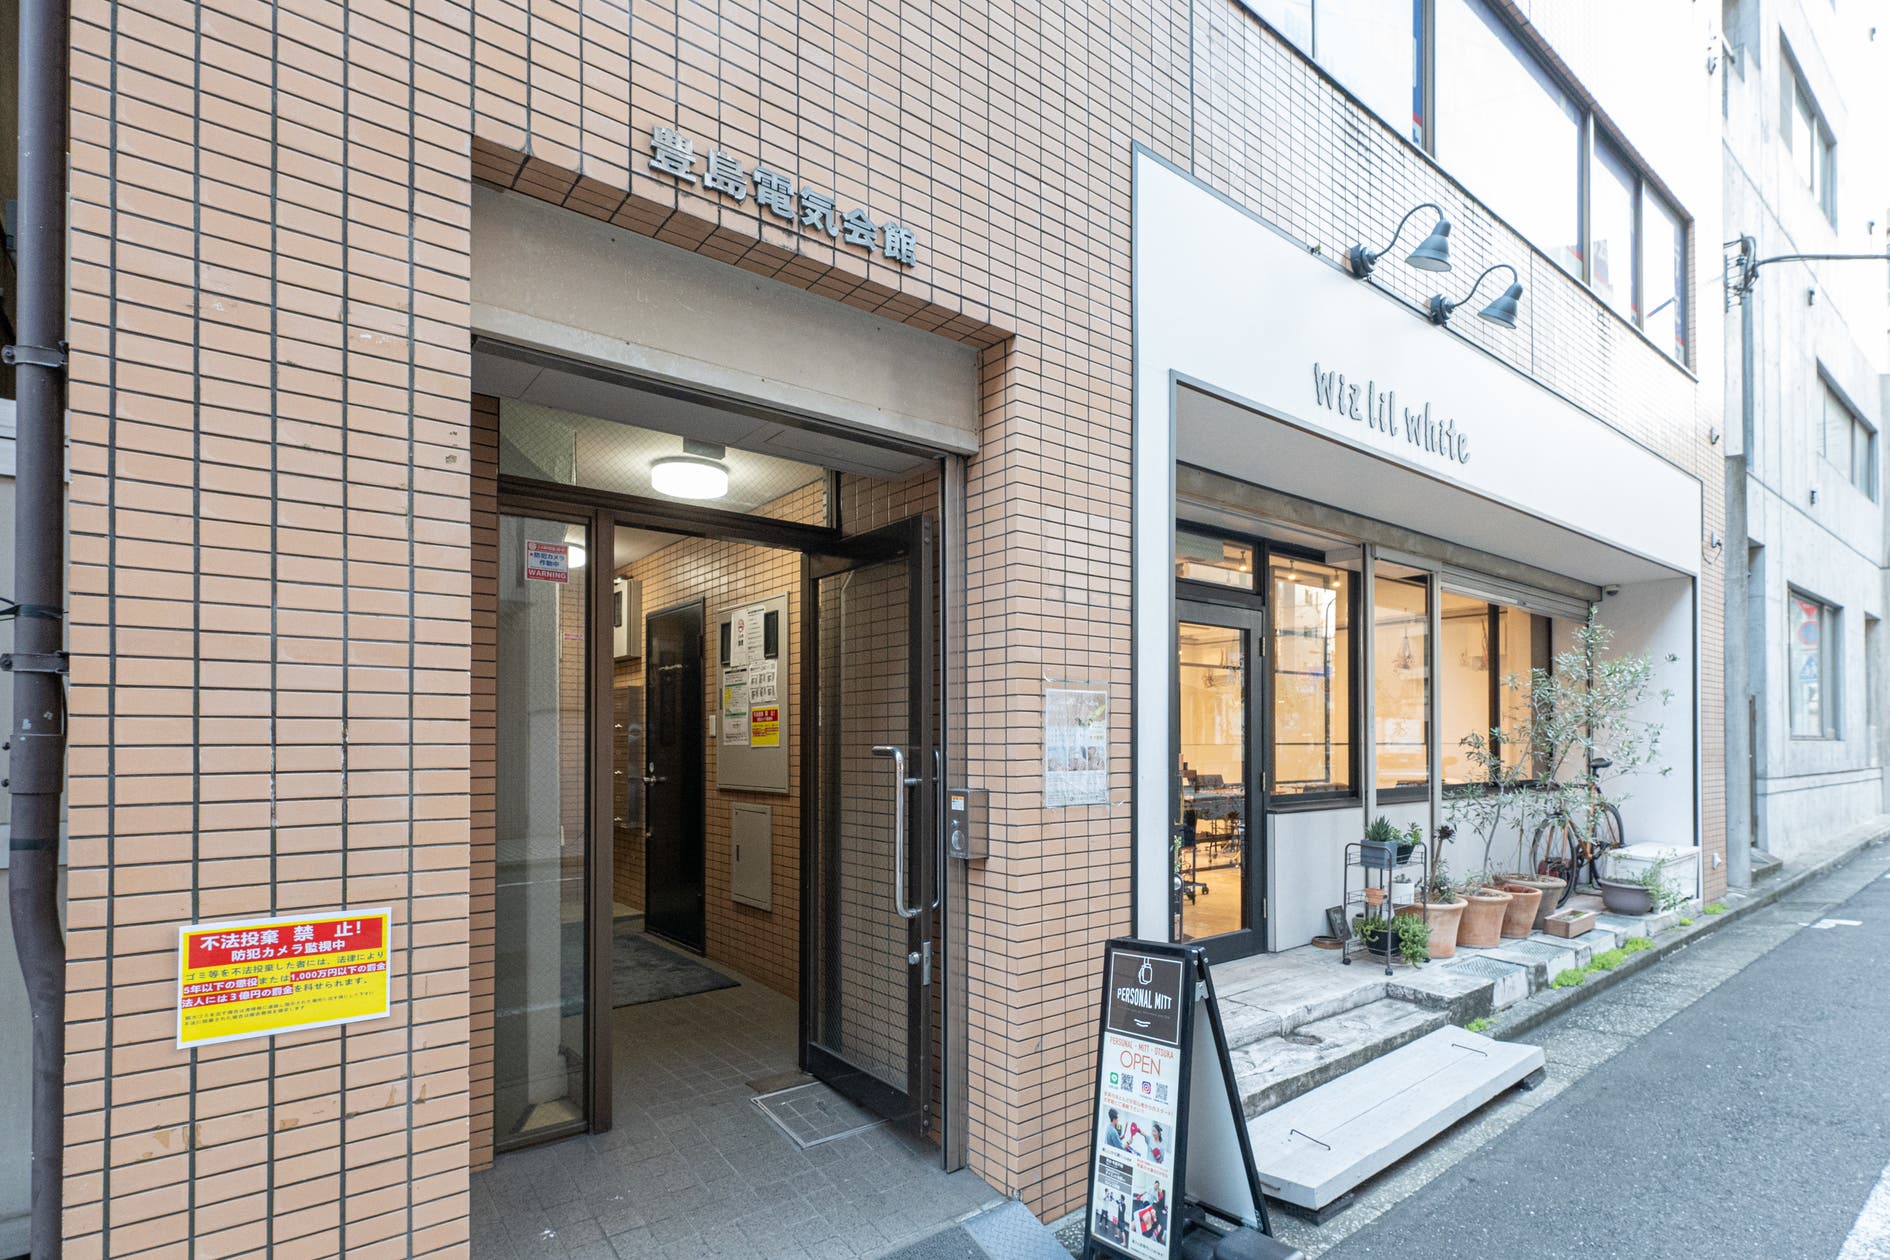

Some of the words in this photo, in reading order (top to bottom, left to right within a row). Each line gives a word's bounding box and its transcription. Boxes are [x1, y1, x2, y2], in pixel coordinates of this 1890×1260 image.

[648, 126, 917, 268] 豊島電気会館
[1404, 401, 1471, 465] white
[528, 569, 567, 579] WARNING
[200, 929, 280, 952] 不法投棄
[293, 924, 315, 942] 禁
[231, 939, 346, 963] 防犯カメラ監視中
[1116, 987, 1153, 1010] PERSONAL
[1154, 992, 1173, 1010] MITT
[1120, 1050, 1162, 1076] OPEN
